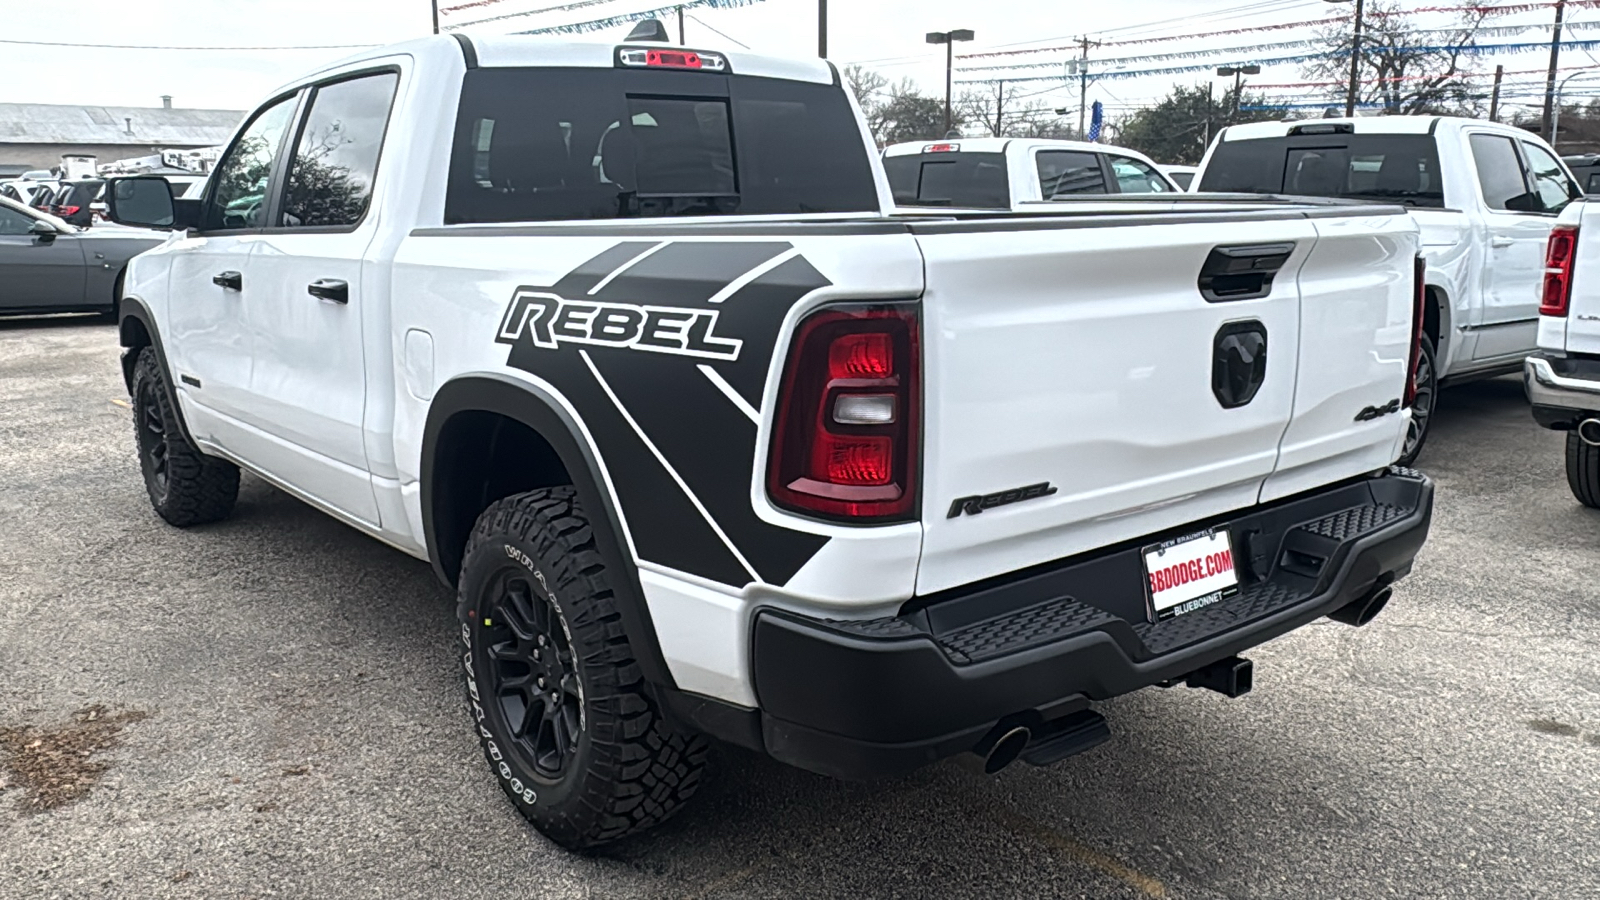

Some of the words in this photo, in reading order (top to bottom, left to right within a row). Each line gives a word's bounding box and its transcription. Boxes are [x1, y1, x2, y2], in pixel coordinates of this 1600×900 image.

[497, 289, 744, 362] REBEL
[946, 481, 1058, 519] REBEL
[1160, 539, 1175, 549] NEW
[1177, 528, 1214, 544] BRAUNFELS
[1174, 591, 1223, 616] BLUEBONNET
[504, 544, 586, 732] WRANGLER
[462, 622, 538, 805] GOODYEAR
